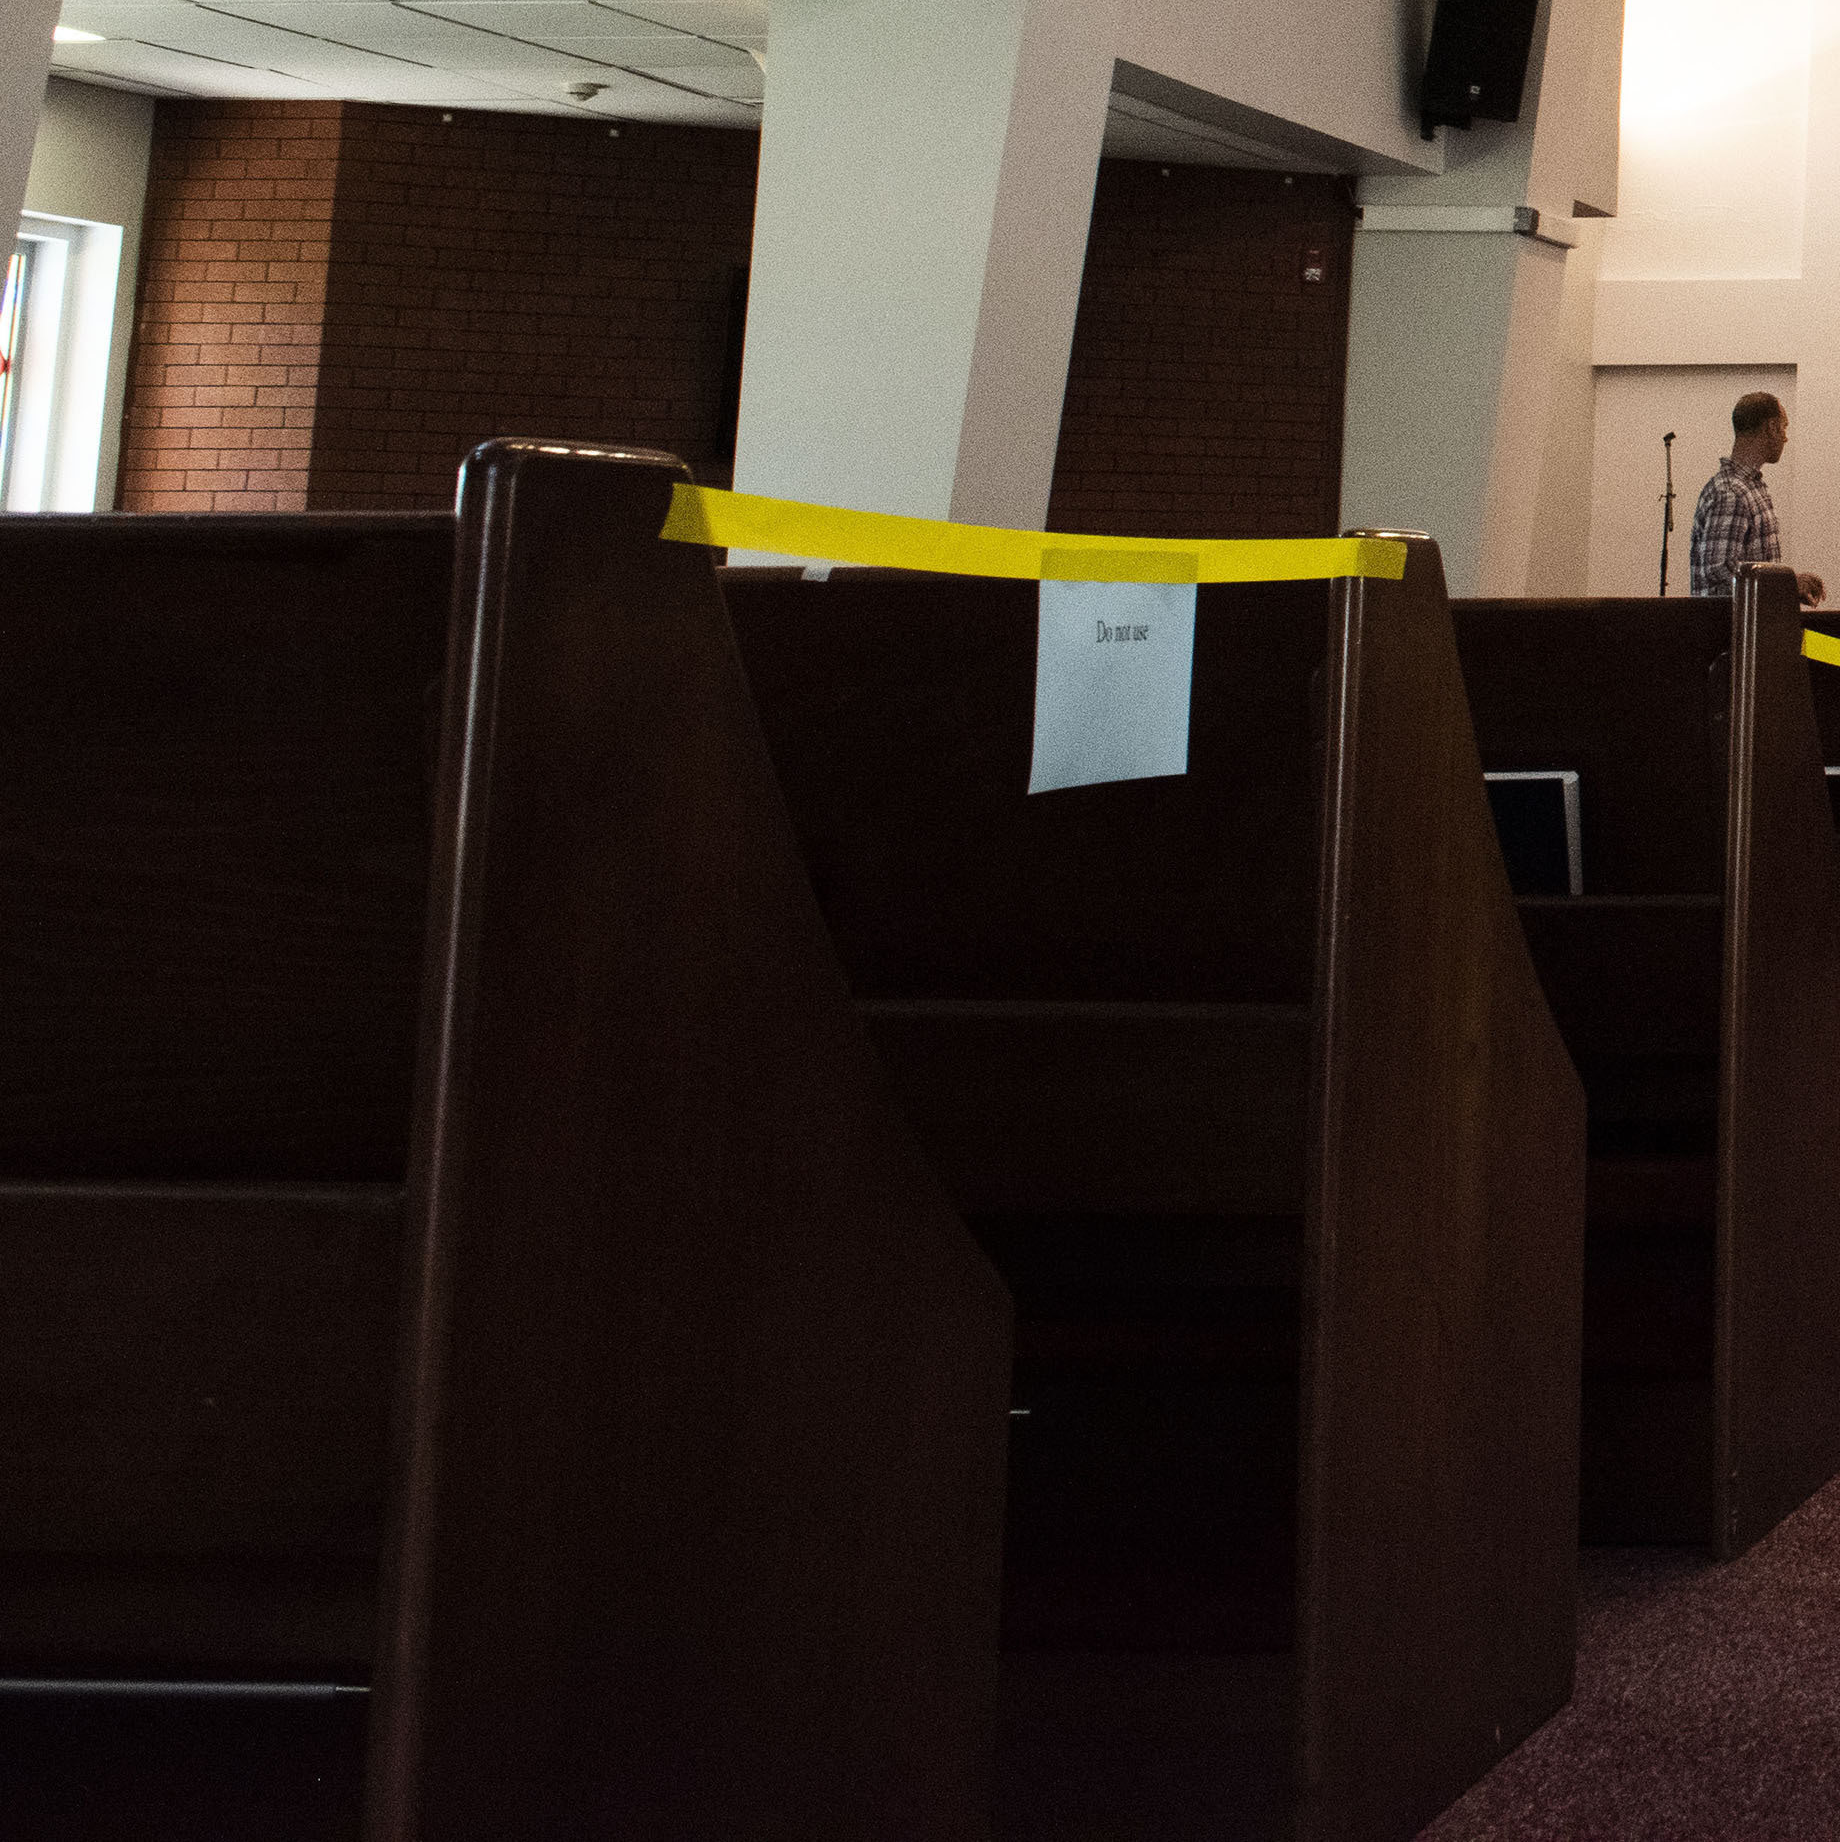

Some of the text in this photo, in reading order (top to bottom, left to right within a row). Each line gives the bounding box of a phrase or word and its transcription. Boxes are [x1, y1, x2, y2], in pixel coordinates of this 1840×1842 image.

[1096, 620, 1149, 643] Do not use
